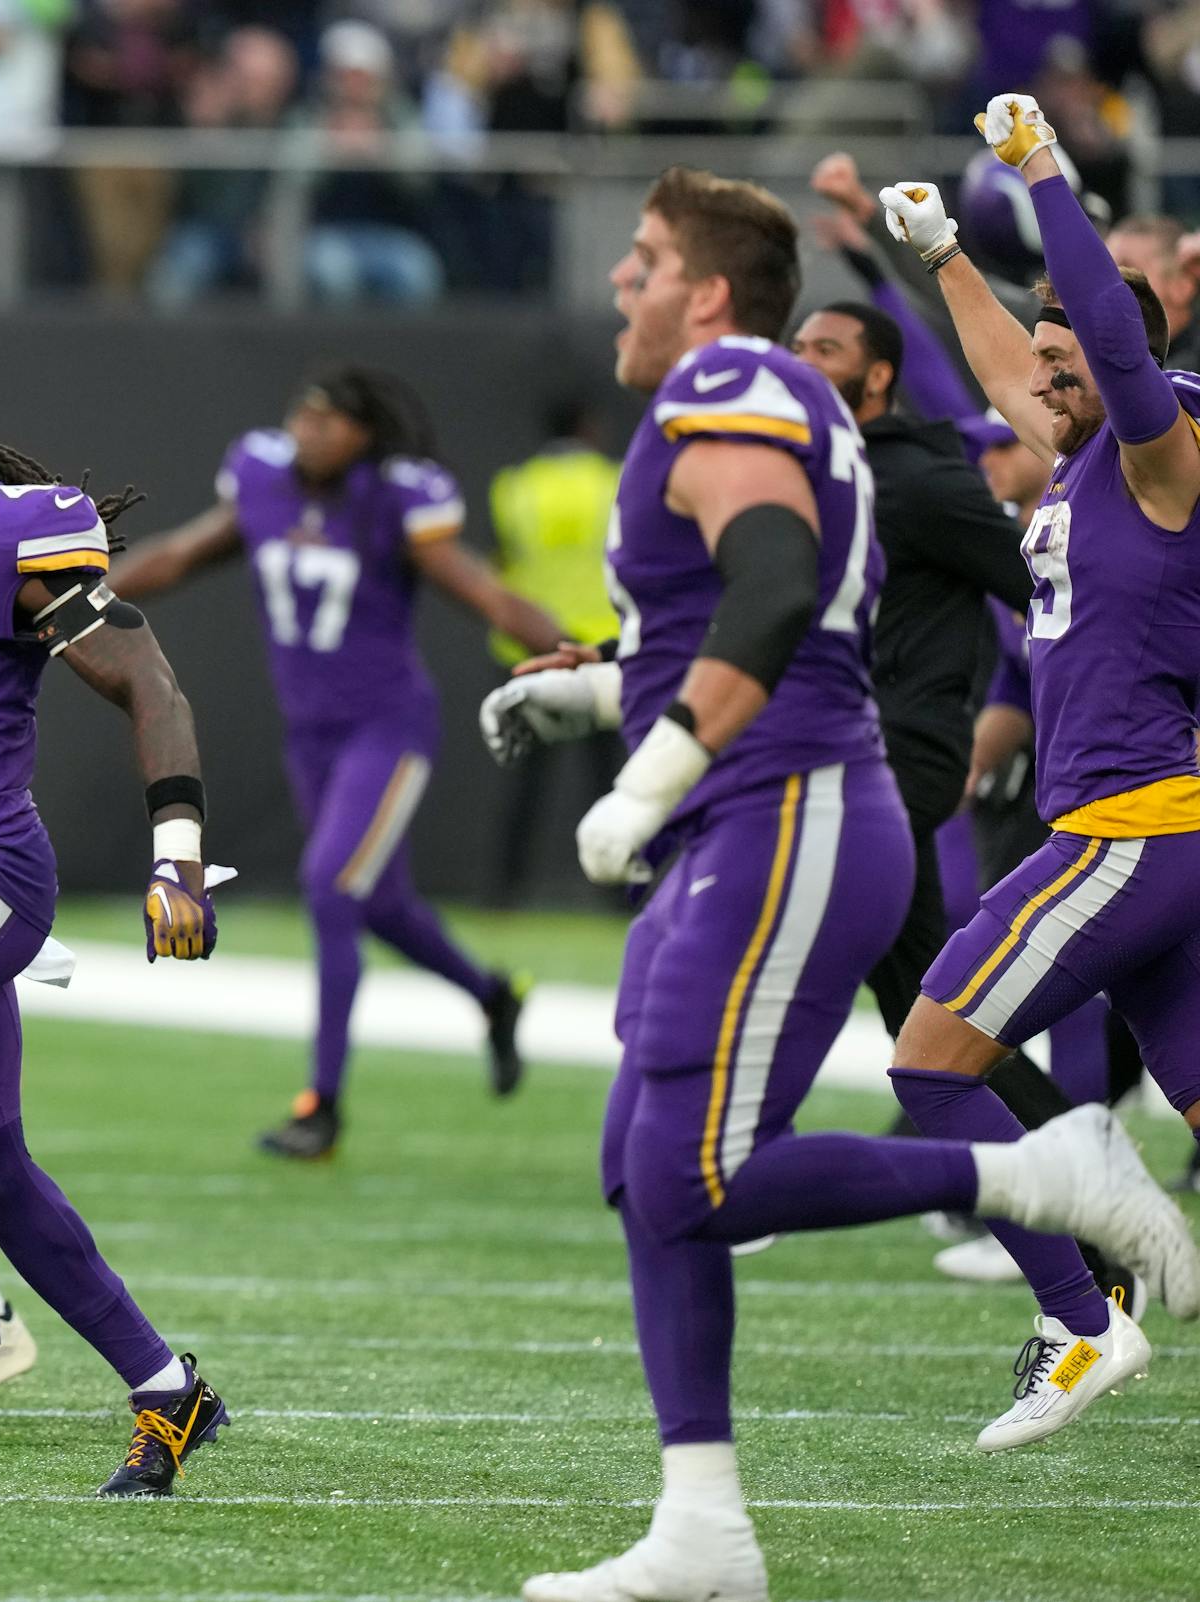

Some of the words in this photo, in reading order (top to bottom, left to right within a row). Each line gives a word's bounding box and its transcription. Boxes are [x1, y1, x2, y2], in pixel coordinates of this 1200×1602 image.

[820, 421, 880, 634] 7
[1020, 500, 1073, 640] 9
[255, 538, 362, 654] 17
[1055, 1345, 1097, 1388] BELIEVE
